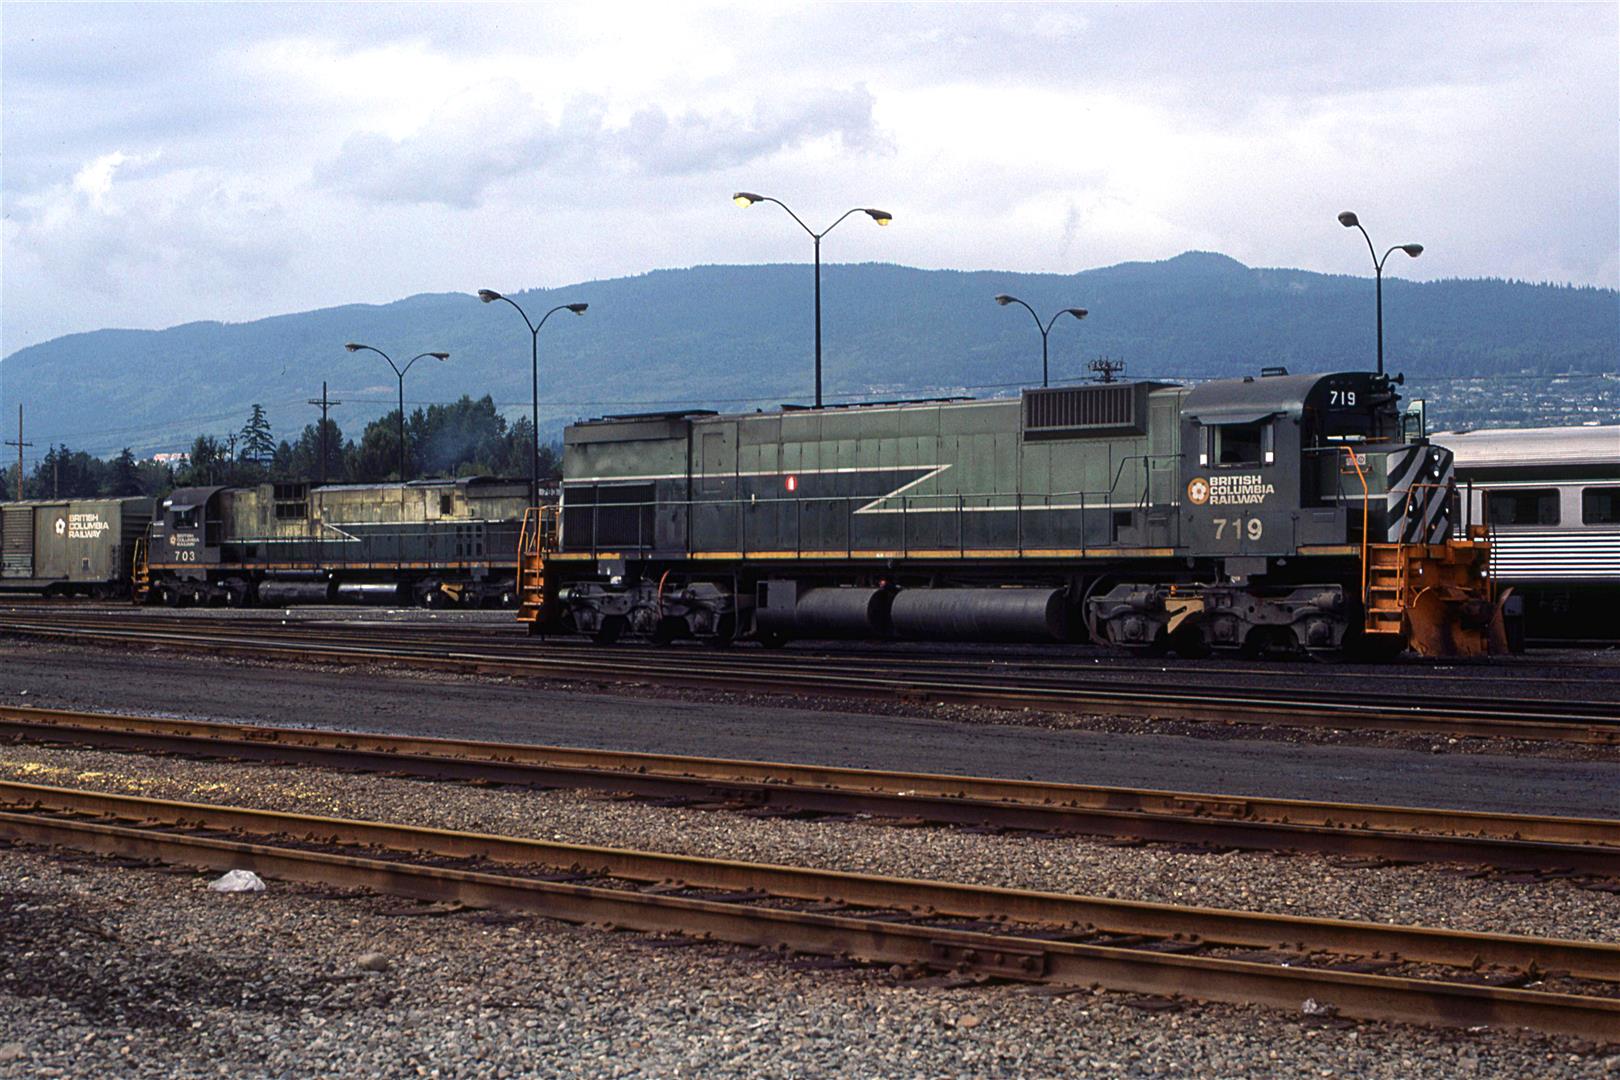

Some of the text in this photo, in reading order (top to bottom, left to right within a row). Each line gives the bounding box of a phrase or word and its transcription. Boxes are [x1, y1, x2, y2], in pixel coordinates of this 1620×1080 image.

[1330, 391, 1356, 406] 719
[1209, 475, 1262, 486] BRITISH
[1209, 484, 1275, 496] COLUMBIA
[1209, 494, 1266, 505] RAILWAY
[68, 514, 99, 522] BRITISH
[68, 522, 110, 530] COLUMBIA
[1213, 518, 1263, 541] 719
[68, 530, 102, 538] RAILWAY
[175, 551, 195, 561] 703
